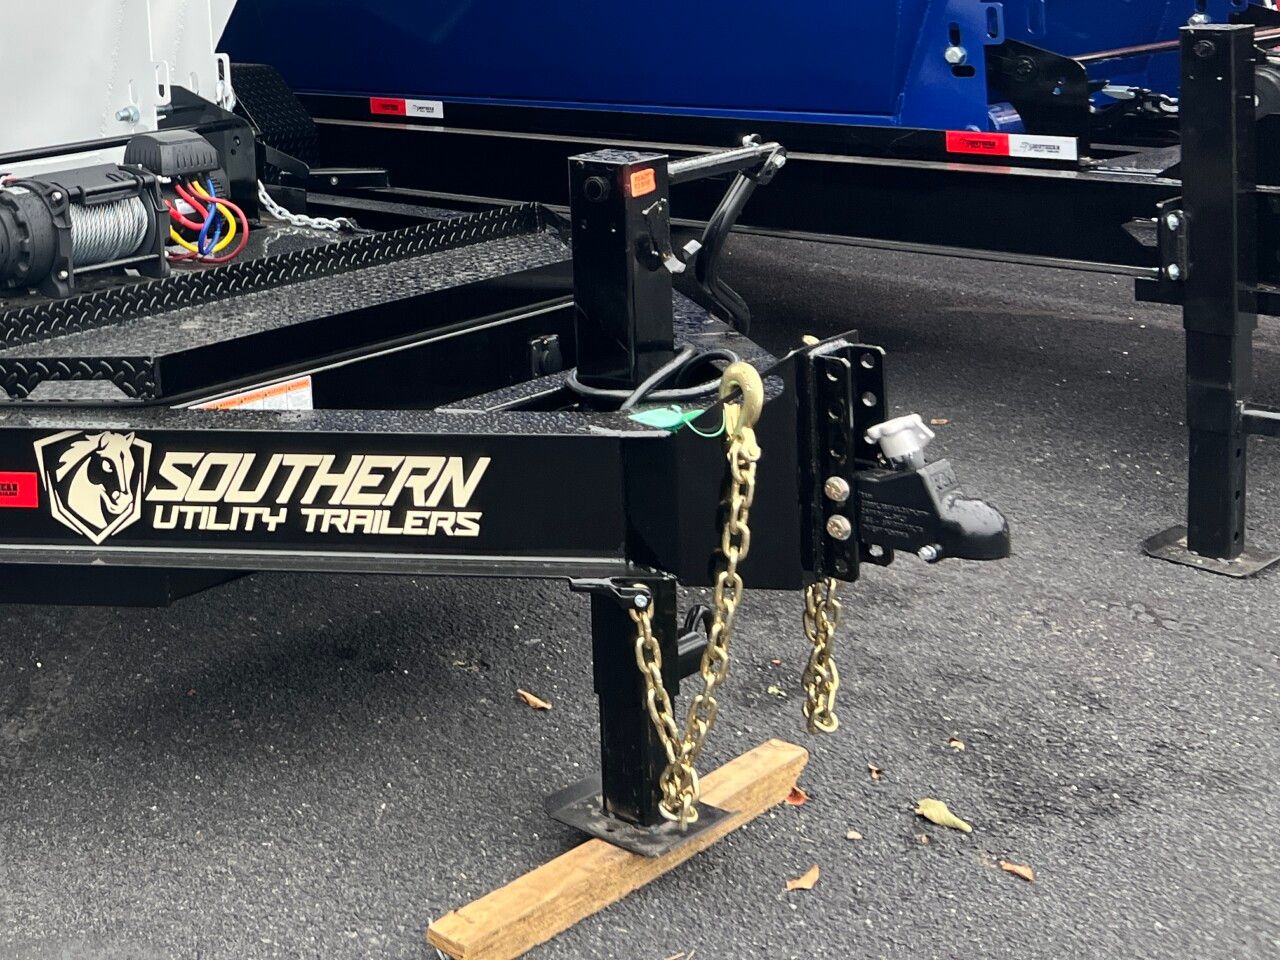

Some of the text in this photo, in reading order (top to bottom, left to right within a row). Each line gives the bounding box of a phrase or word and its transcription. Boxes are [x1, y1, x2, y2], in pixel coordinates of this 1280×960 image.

[145, 451, 491, 507] SOUTHERN
[153, 504, 483, 536] UTILITY TRAILERS
